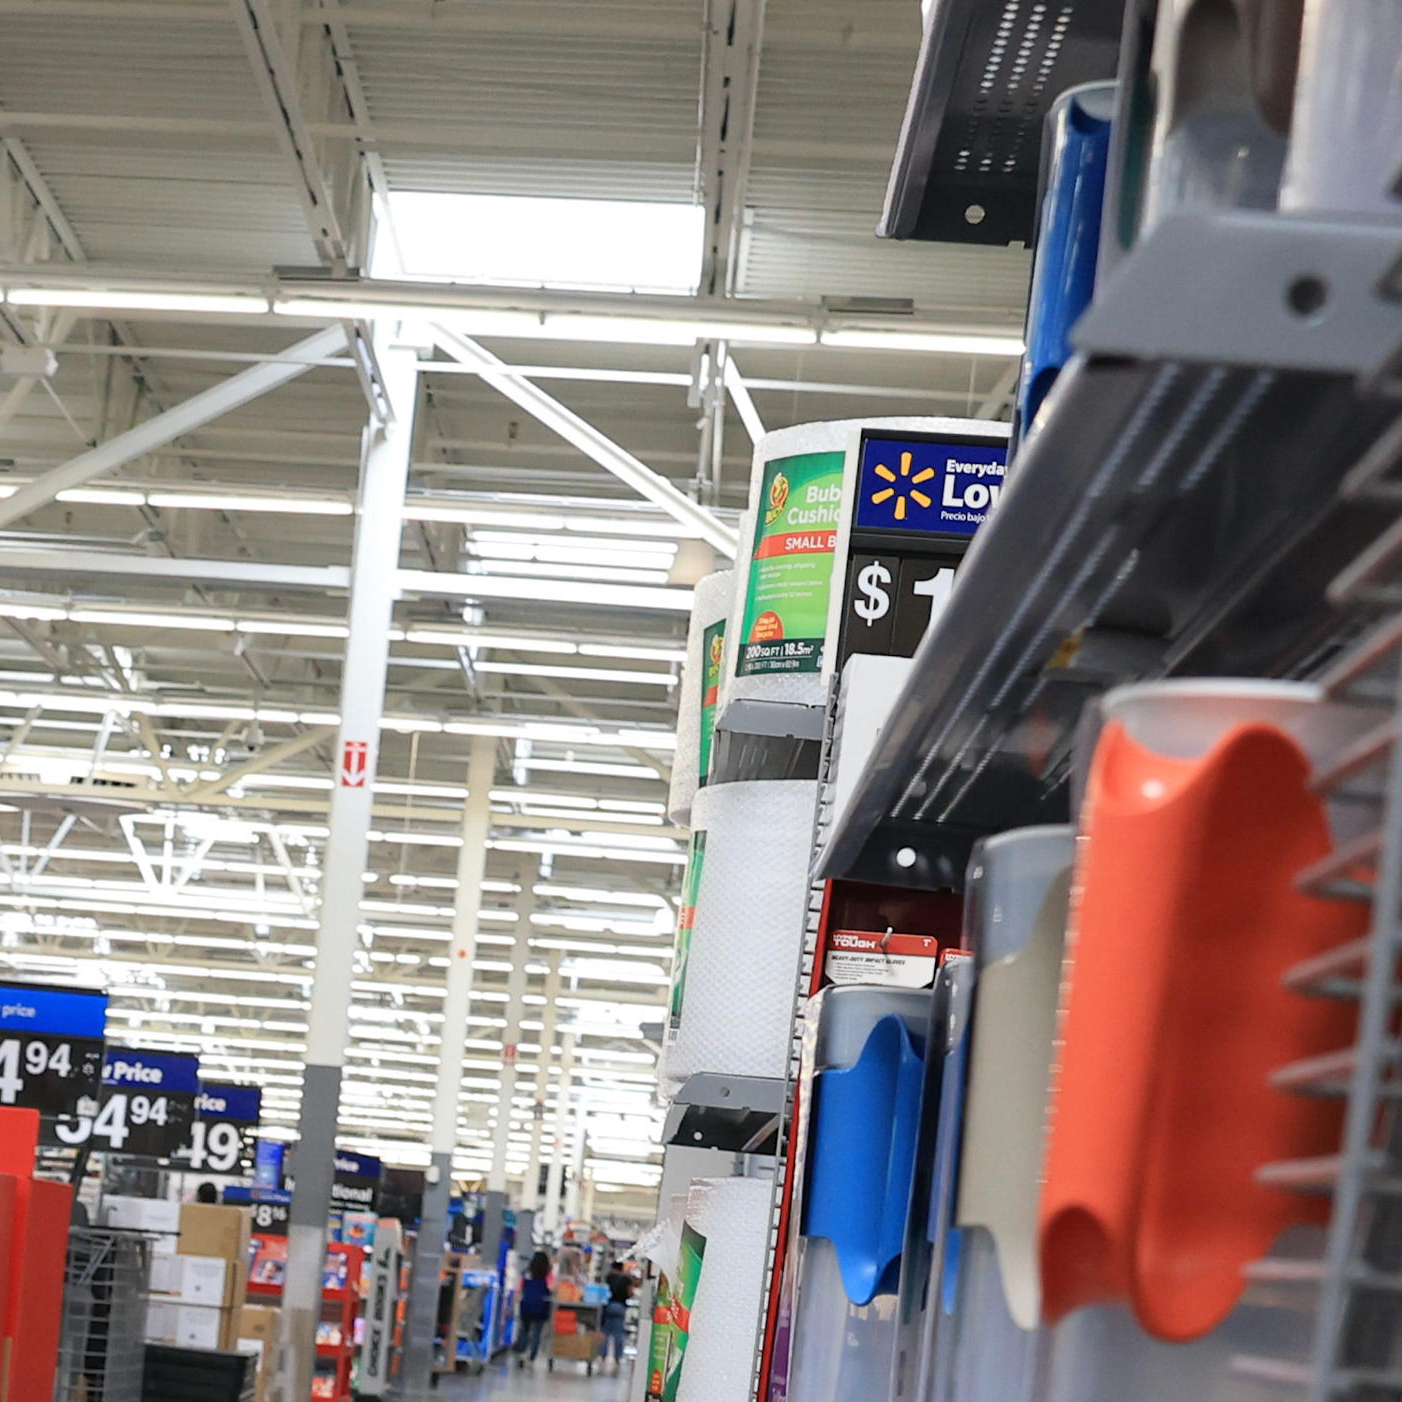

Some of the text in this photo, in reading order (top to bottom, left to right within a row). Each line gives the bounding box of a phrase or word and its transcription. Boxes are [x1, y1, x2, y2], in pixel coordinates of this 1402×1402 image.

[940, 510, 987, 523] Precio bajo
[785, 536, 825, 550] SMALL
[834, 939, 877, 949] TOUGH
[1, 1003, 36, 1019] price
[113, 1061, 164, 1084] Price
